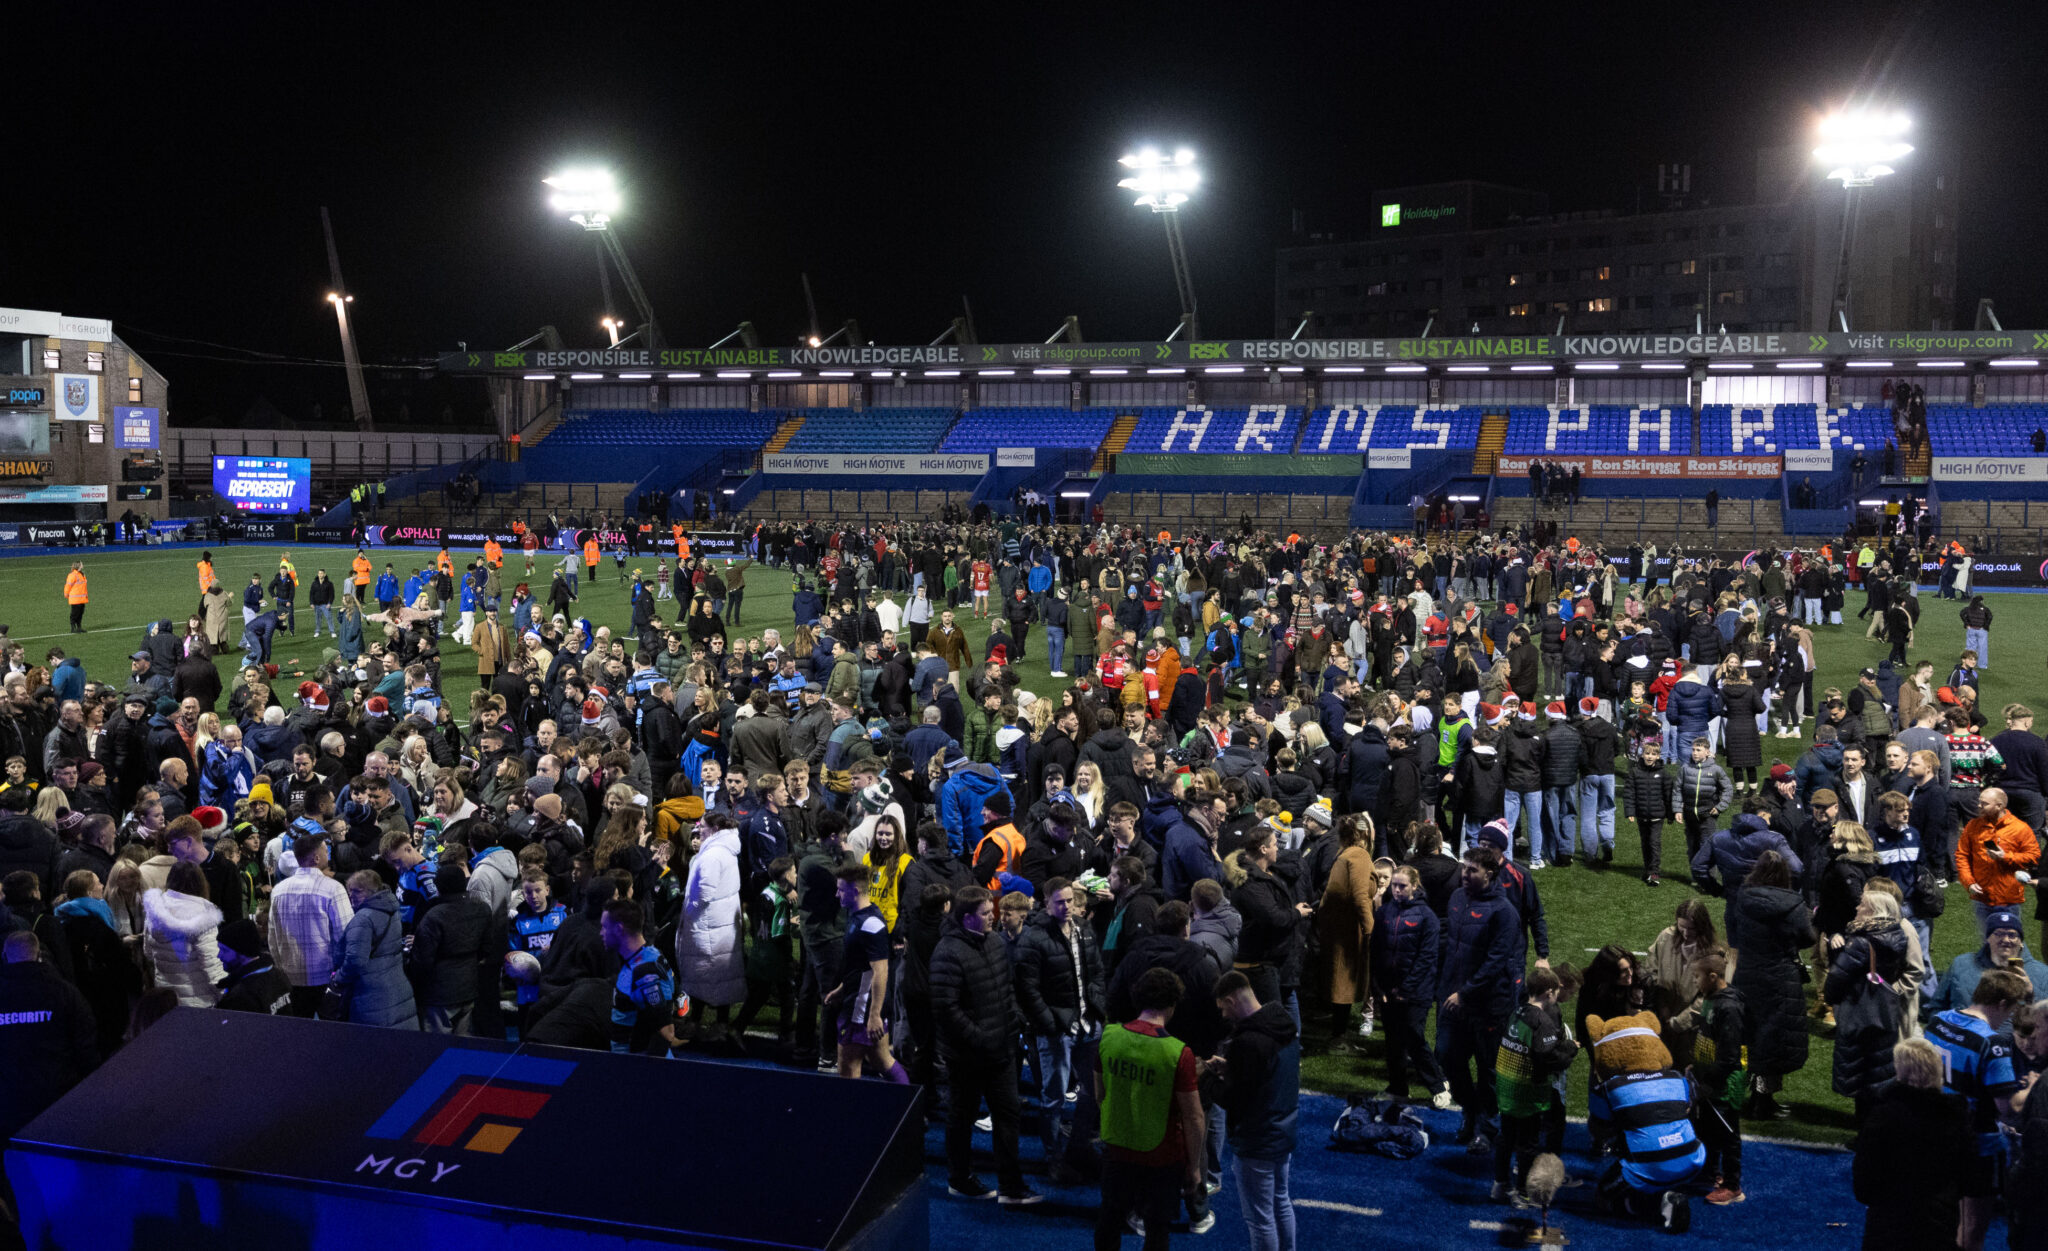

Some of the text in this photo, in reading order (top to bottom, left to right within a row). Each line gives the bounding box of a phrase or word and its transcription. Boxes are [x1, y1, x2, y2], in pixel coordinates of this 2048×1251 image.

[1403, 207, 1439, 220] Holiday
[1189, 335, 1786, 359] RSK RESPONSIBLE. SUSTAINABLE. KNOWLEDGEABLE.
[1848, 334, 2013, 351] visit rskgroup.com
[494, 347, 964, 367] RSK RESPONSIBLE. SUSTAINABLE. KNOWLEDGEABLE.
[1012, 346, 1140, 361] visit rskgroup.com
[10, 389, 40, 404] popin
[769, 459, 829, 469] HIGH MOTIVE
[843, 459, 905, 469] HIGH MOTIVE
[920, 459, 983, 469] HIGH MOTIVE
[1500, 458, 1527, 469] Ron
[1592, 459, 1680, 471] Ron Skinner
[1687, 459, 1778, 471] Ron Skinner
[1940, 464, 2025, 475] HIGH MOTIVE
[227, 479, 296, 497] REPRESENT
[38, 530, 65, 538] macron
[396, 528, 442, 539] ASPHALT
[0, 1010, 52, 1025] SECURITY
[1108, 1056, 1156, 1086] MEDIC
[355, 1153, 461, 1182] MGY
